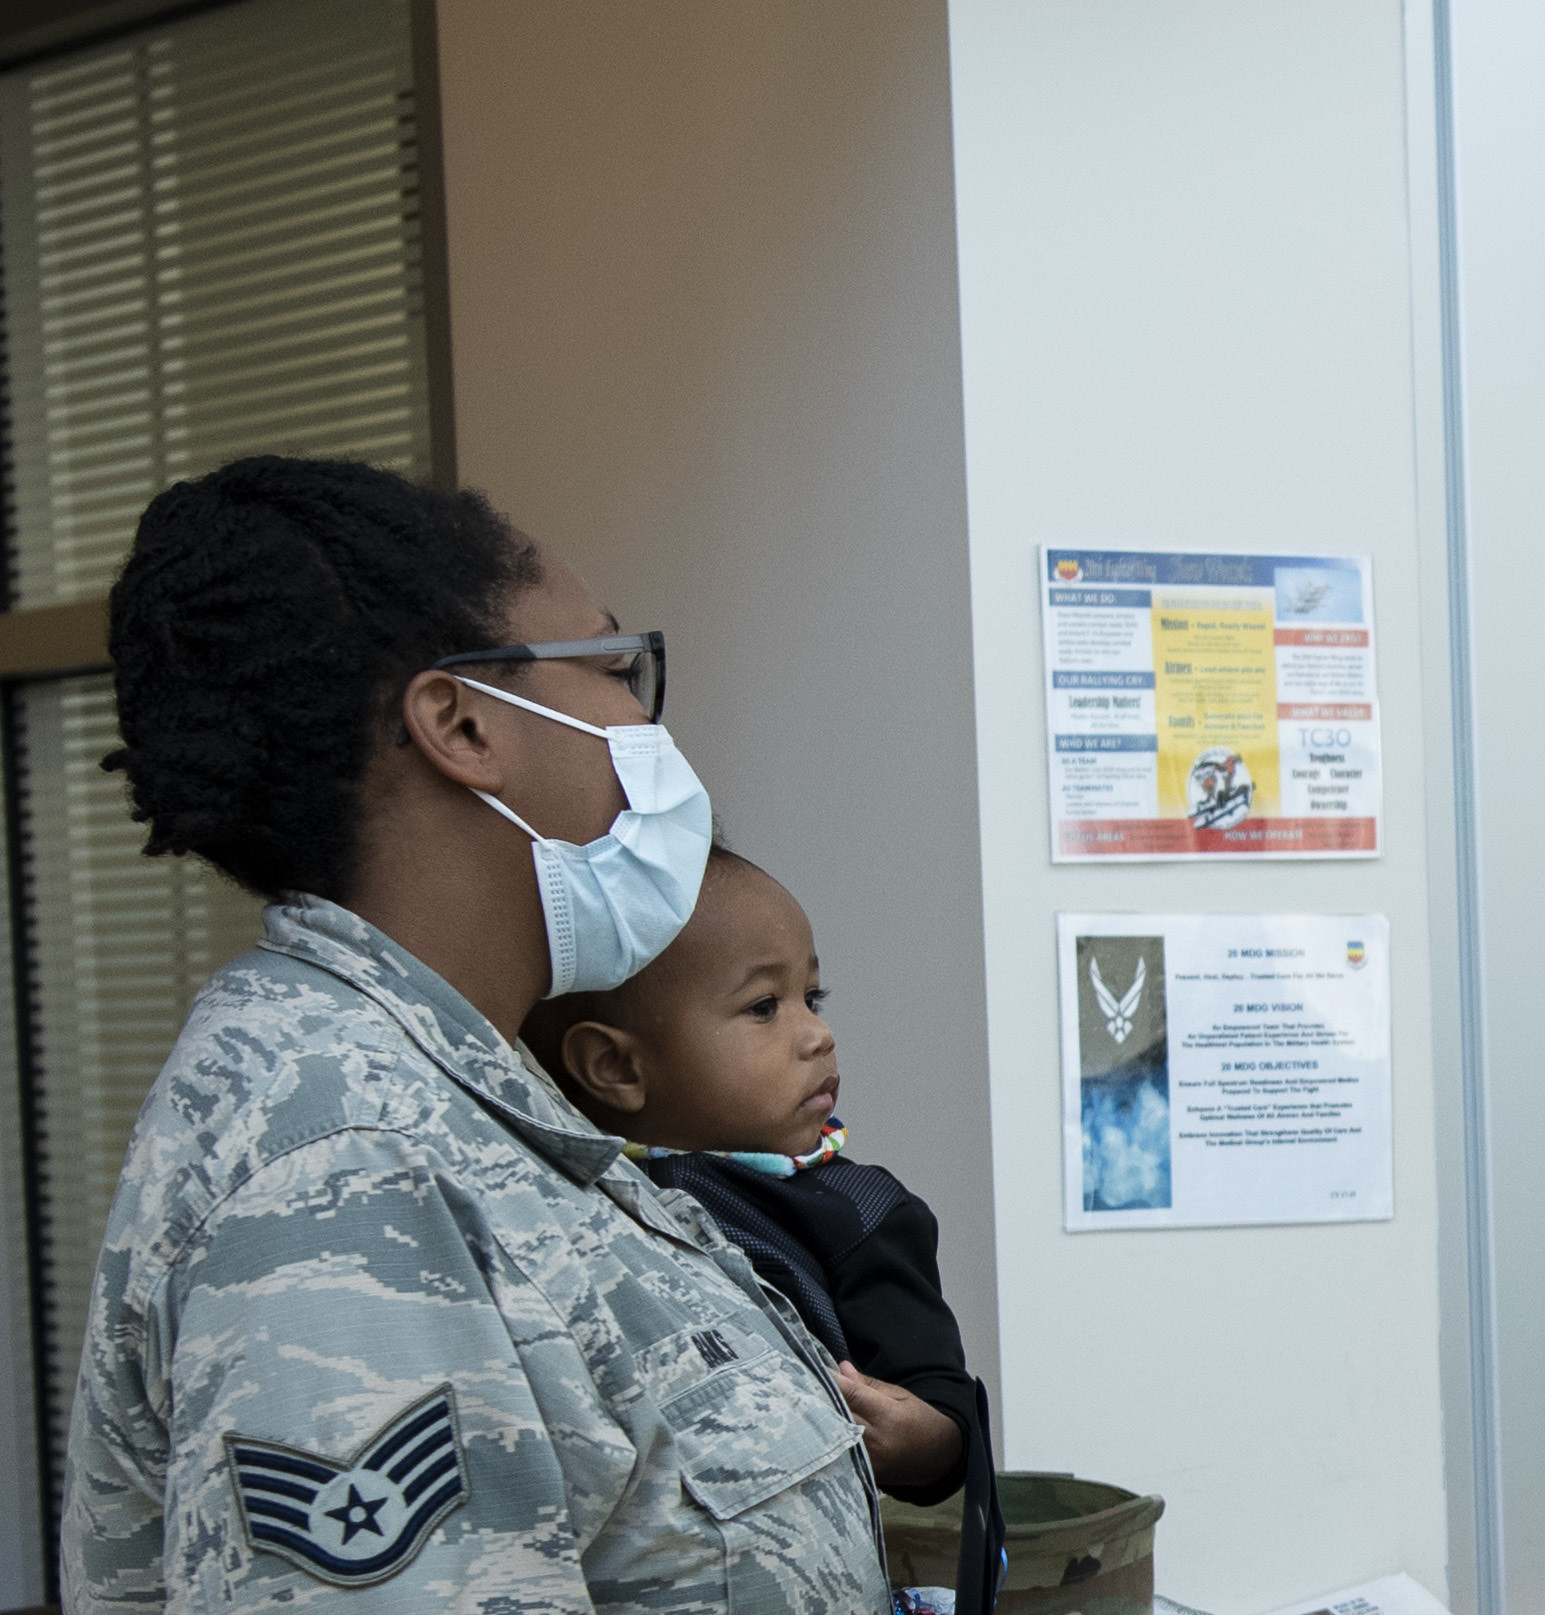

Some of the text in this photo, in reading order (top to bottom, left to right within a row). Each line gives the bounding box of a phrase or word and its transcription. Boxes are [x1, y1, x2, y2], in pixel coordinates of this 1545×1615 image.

[1084, 593, 1098, 604] WE
[1228, 949, 1305, 958] 20 MDG MISSION
[1233, 1003, 1303, 1013] 20 MDG VISION
[1221, 1061, 1319, 1071] 20 MDG OBJECTIVES
